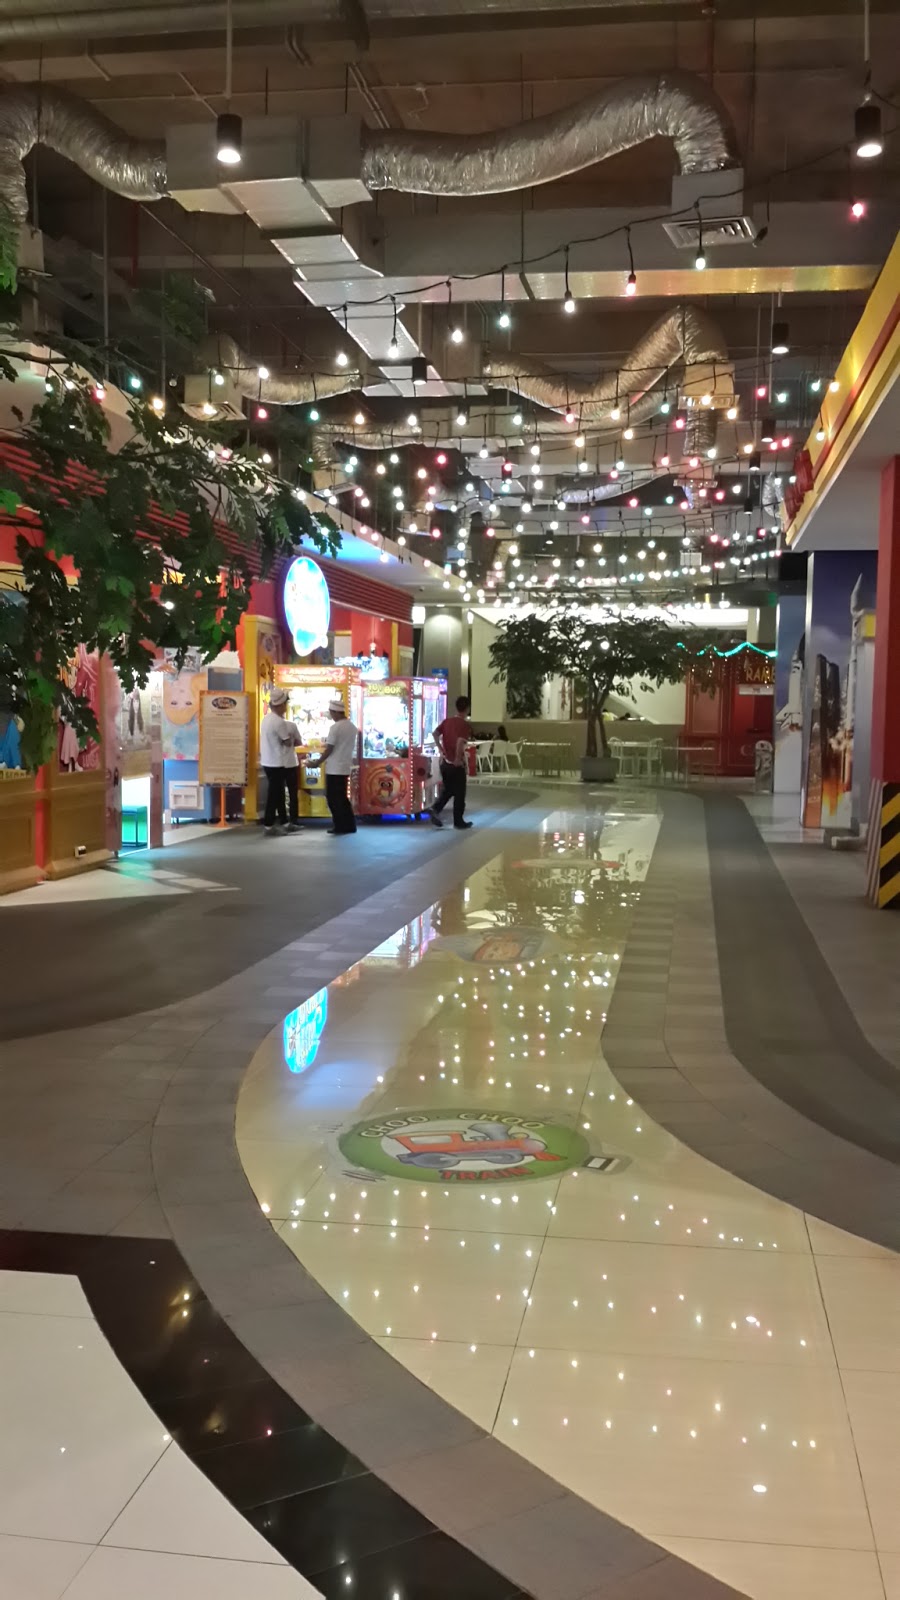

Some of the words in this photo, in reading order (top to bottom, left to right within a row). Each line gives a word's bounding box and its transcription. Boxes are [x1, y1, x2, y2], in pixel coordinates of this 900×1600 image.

[384, 685, 402, 695] BOX
[361, 1115, 430, 1138] CHOO
[457, 1113, 545, 1129] CHOO
[441, 1167, 535, 1181] TRAIN
